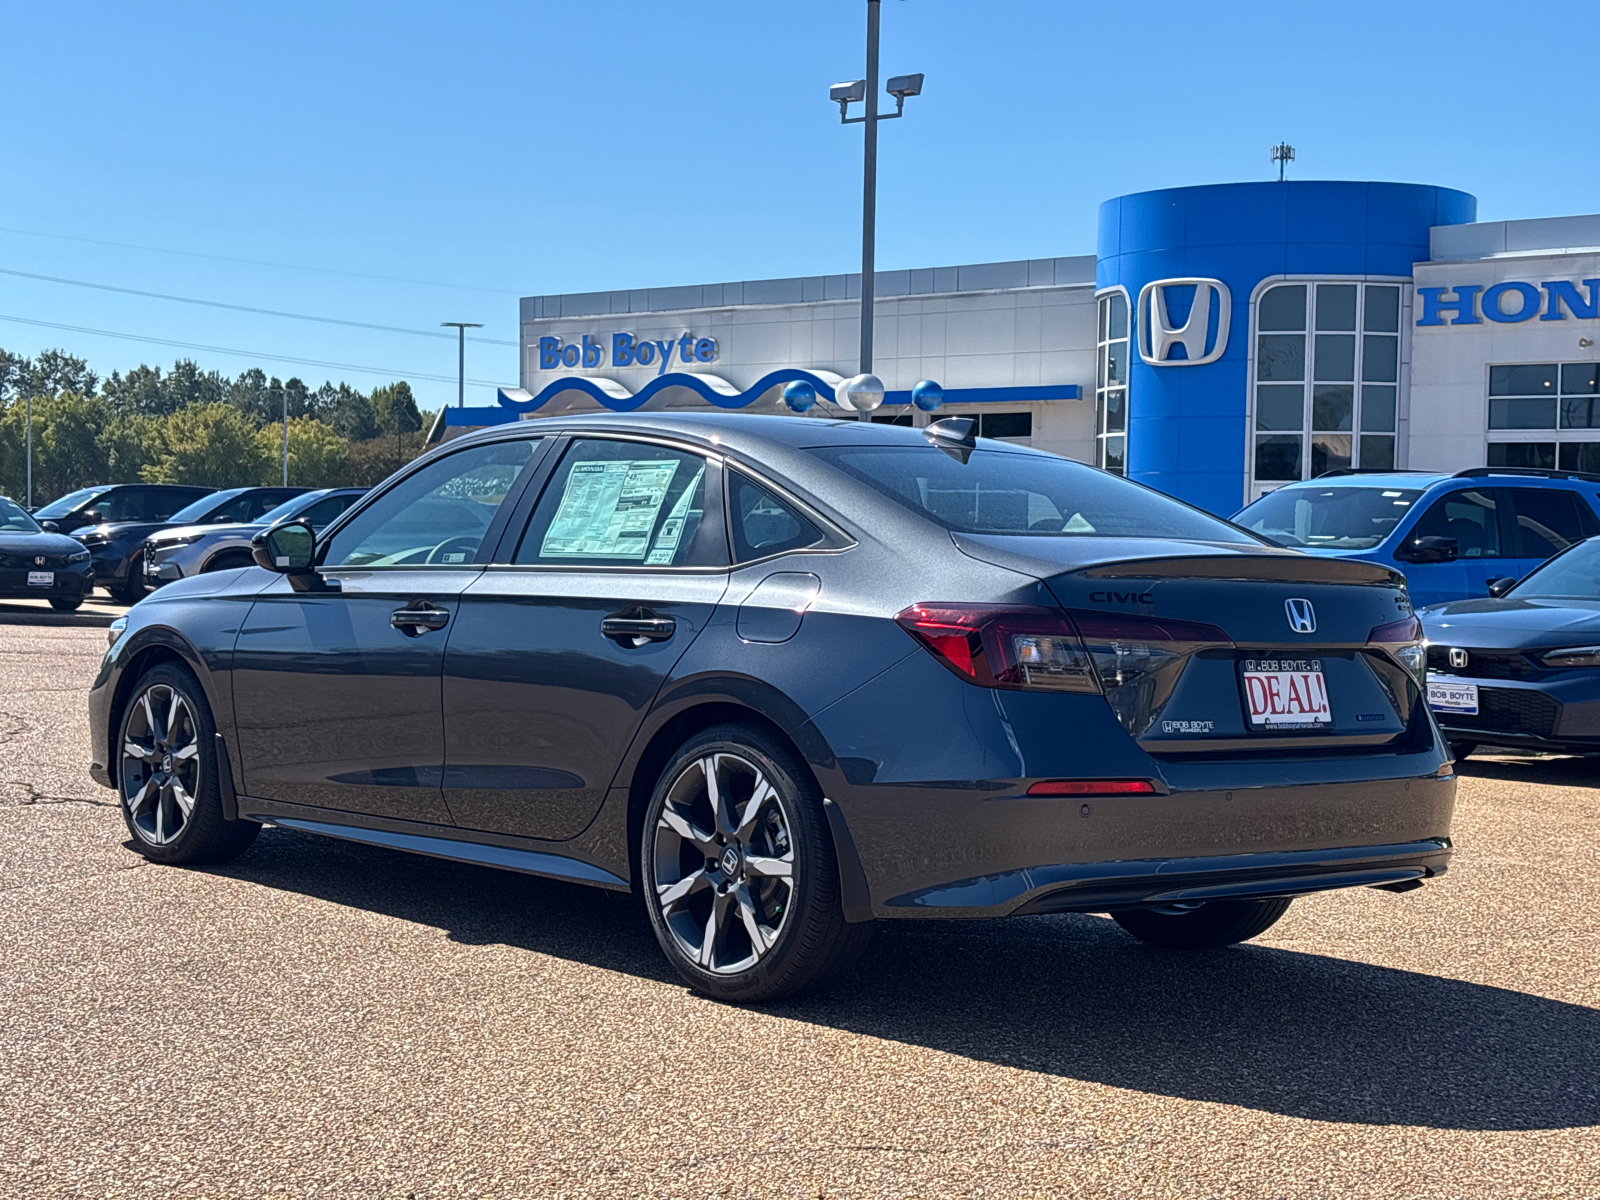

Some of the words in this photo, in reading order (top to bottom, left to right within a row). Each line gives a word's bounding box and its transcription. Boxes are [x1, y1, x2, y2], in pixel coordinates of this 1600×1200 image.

[539, 335, 602, 370] Bob
[612, 331, 716, 376] Boyte
[1088, 591, 1154, 605] CIVIC
[1261, 660, 1279, 671] BOB
[1281, 660, 1308, 671] BOYTE
[1244, 674, 1327, 716] DEAL!
[1431, 690, 1447, 699] BOB
[1449, 692, 1475, 701] BOYTE
[1173, 720, 1189, 729] BOB
[1190, 720, 1215, 729] BOYTE
